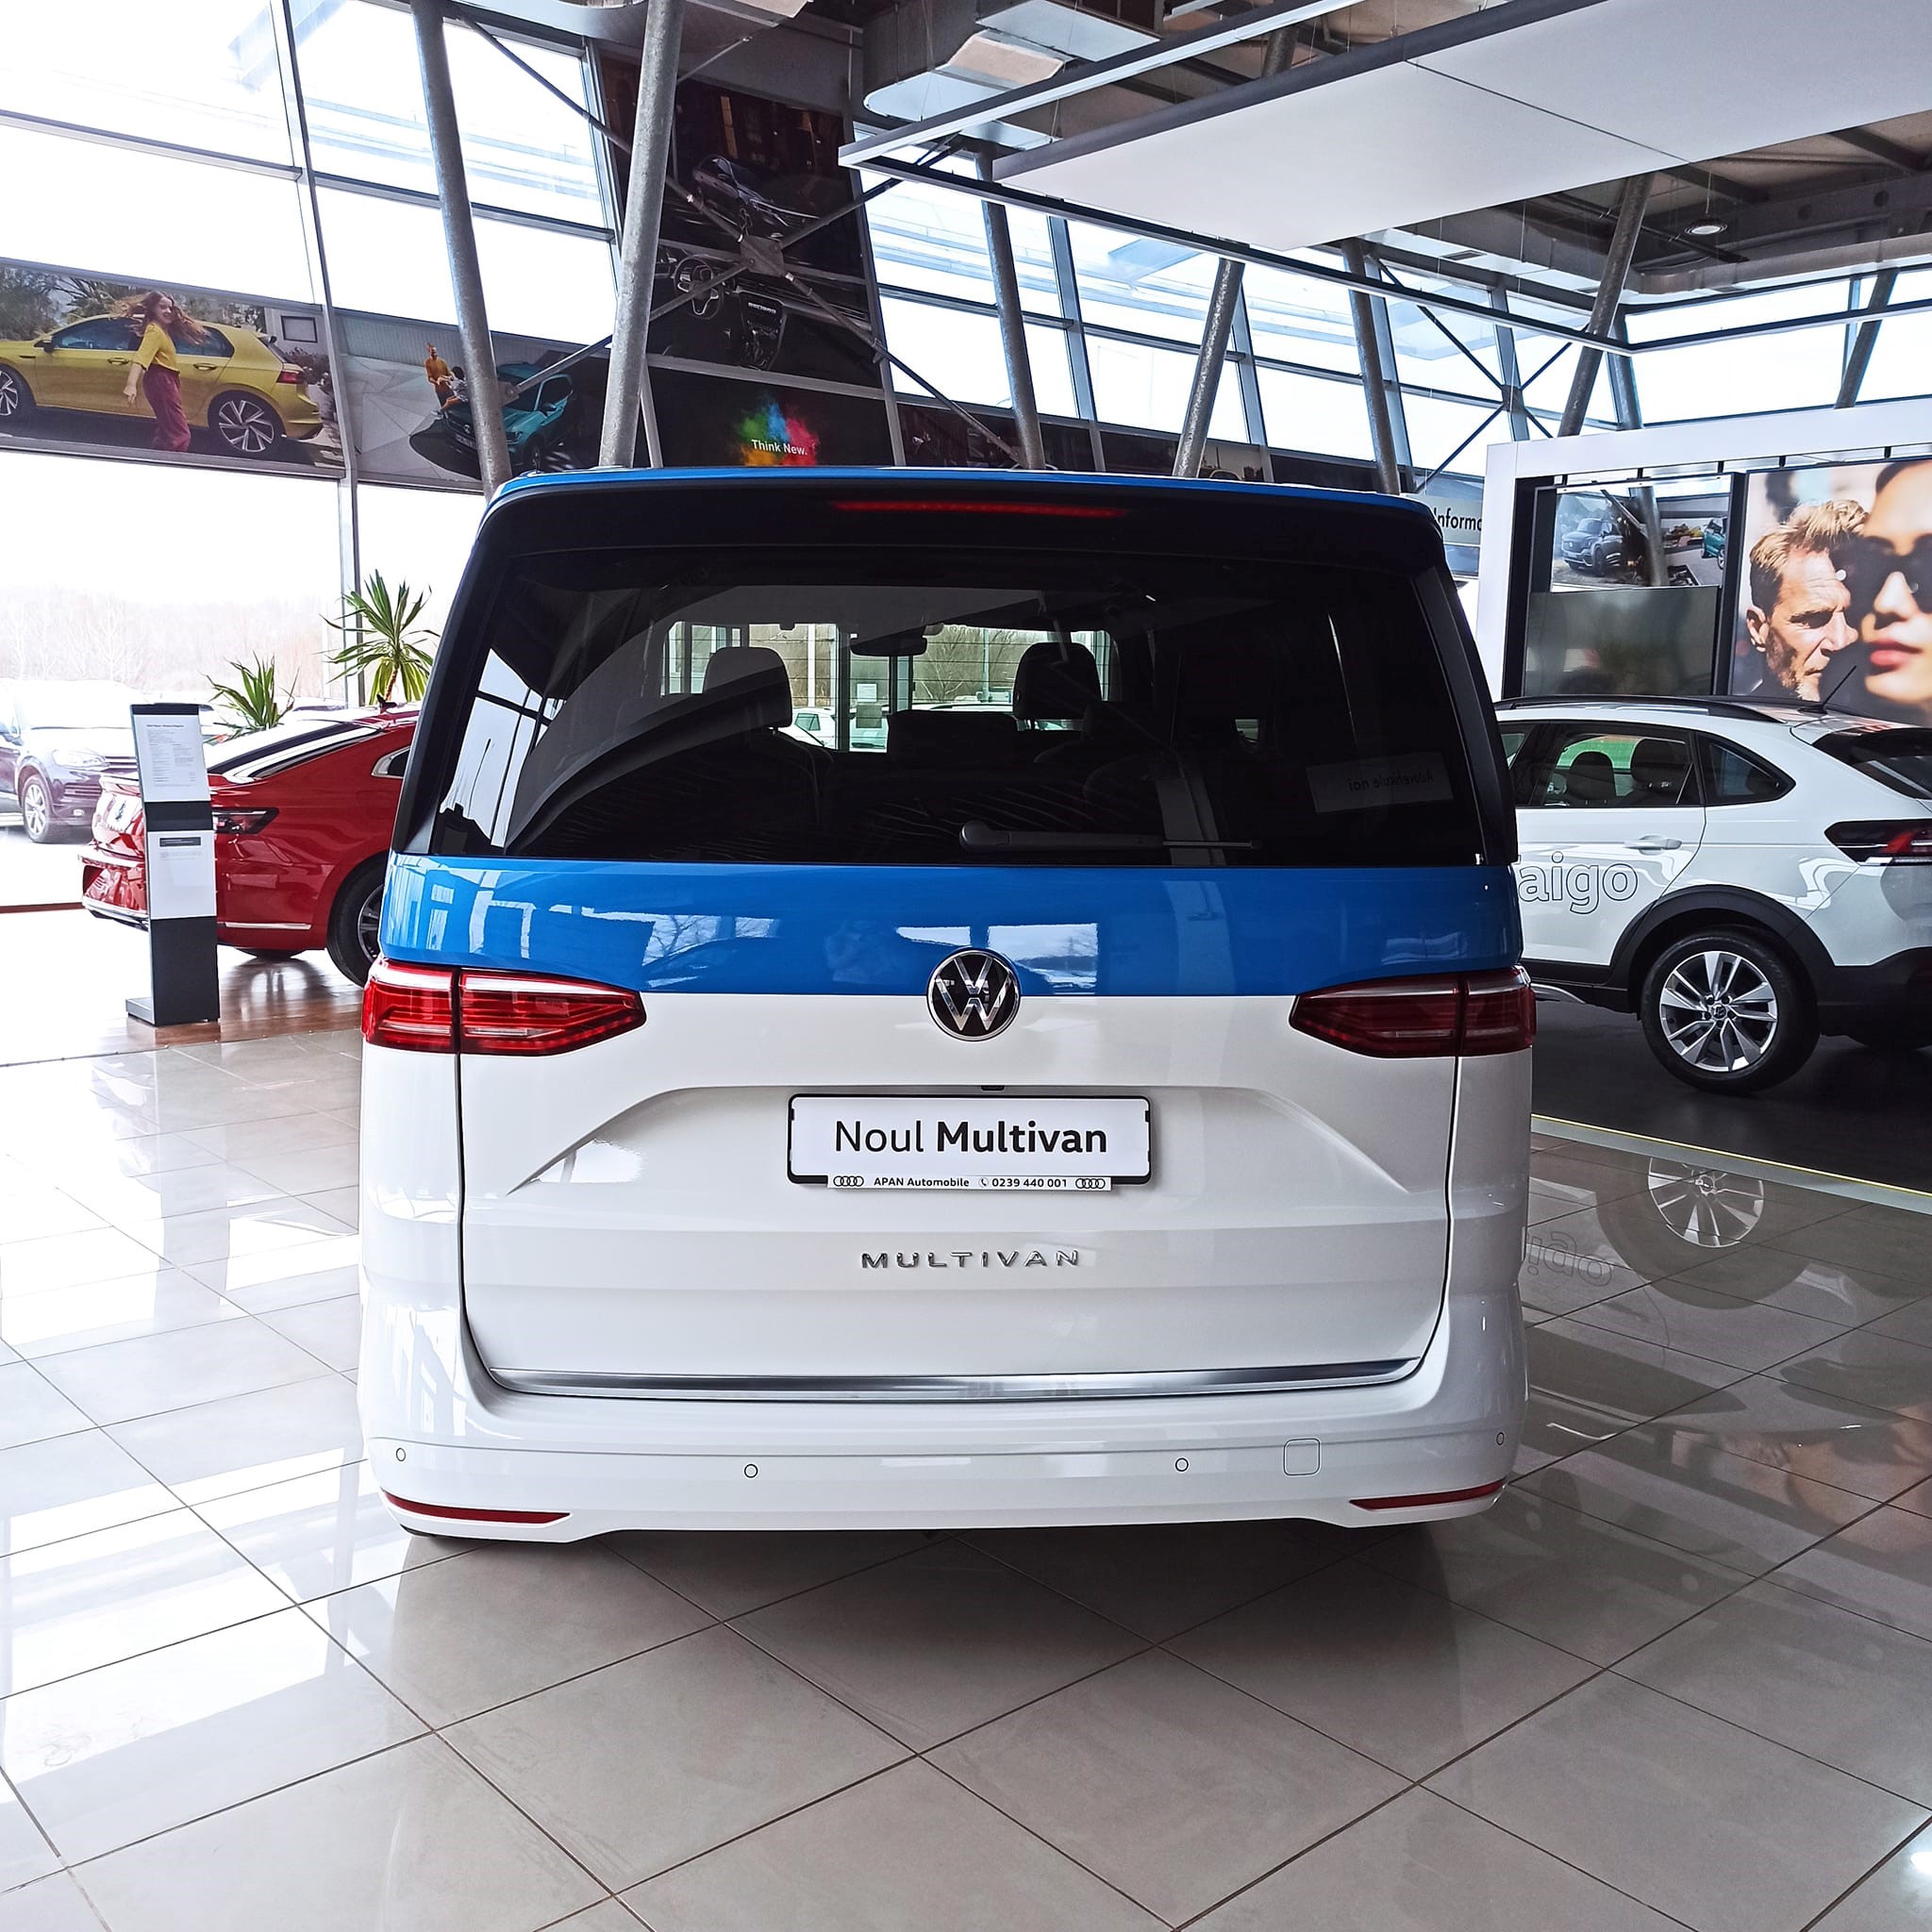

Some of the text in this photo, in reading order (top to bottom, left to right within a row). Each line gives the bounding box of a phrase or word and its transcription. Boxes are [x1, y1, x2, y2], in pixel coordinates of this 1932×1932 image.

[751, 439, 808, 456] Think New.
[1515, 851, 1639, 915] aigo
[836, 1120, 1108, 1153] Noul Multivan
[874, 1176, 1067, 1188] APAN Automobile 0239 440 001
[860, 1250, 1079, 1269] MULTIVAN
